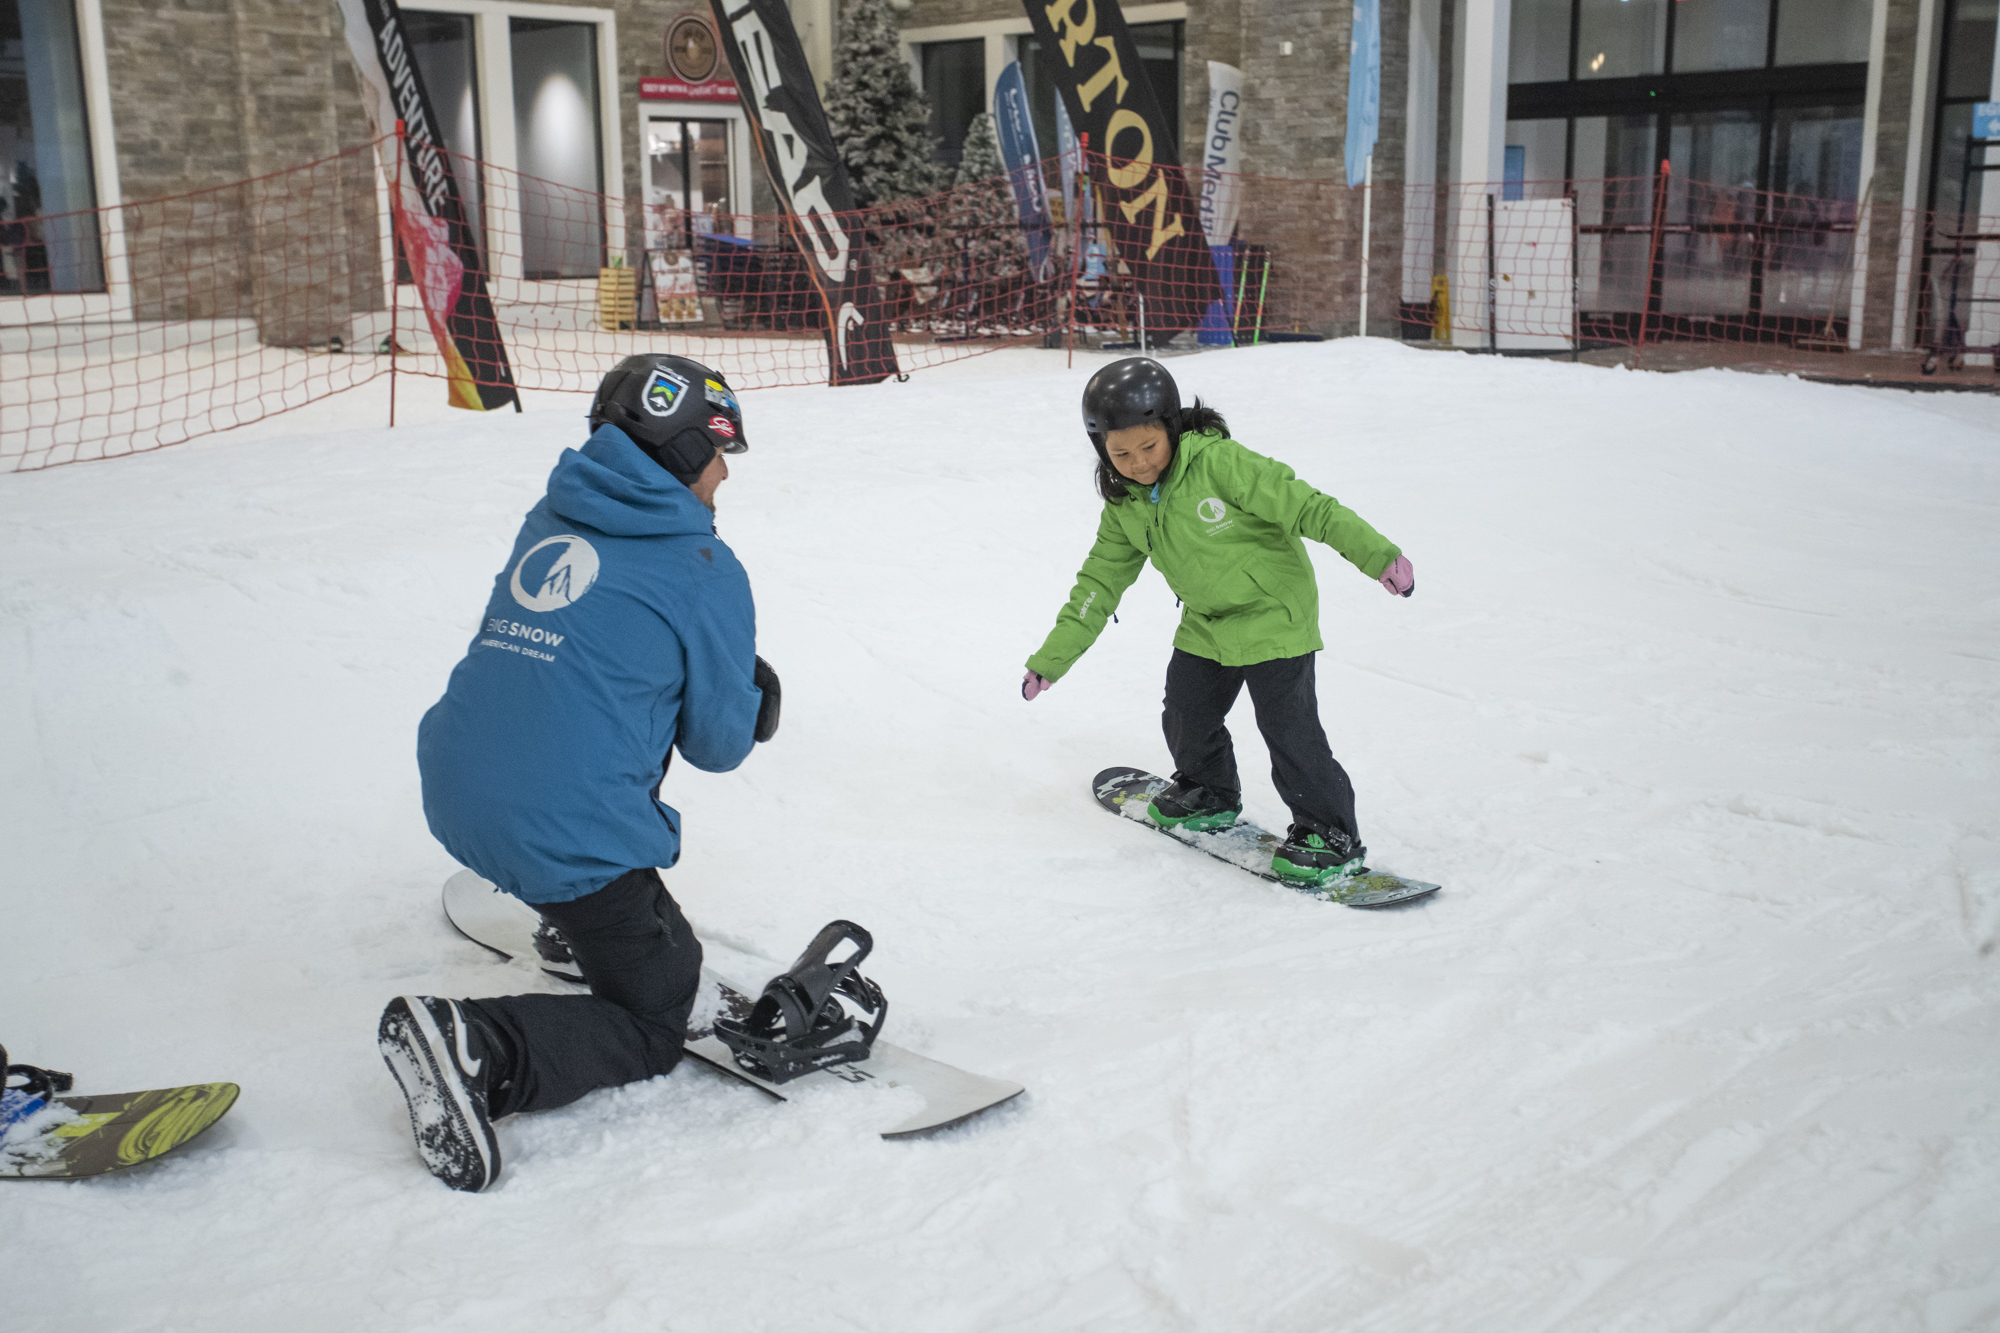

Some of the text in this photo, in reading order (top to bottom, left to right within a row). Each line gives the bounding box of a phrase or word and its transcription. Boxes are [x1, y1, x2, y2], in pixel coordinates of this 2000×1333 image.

[379, 17, 448, 216] ADVENTURE
[721, 0, 850, 283] EAD
[1200, 90, 1240, 215] Club Med
[480, 638, 555, 662] AMERICAN DREAM
